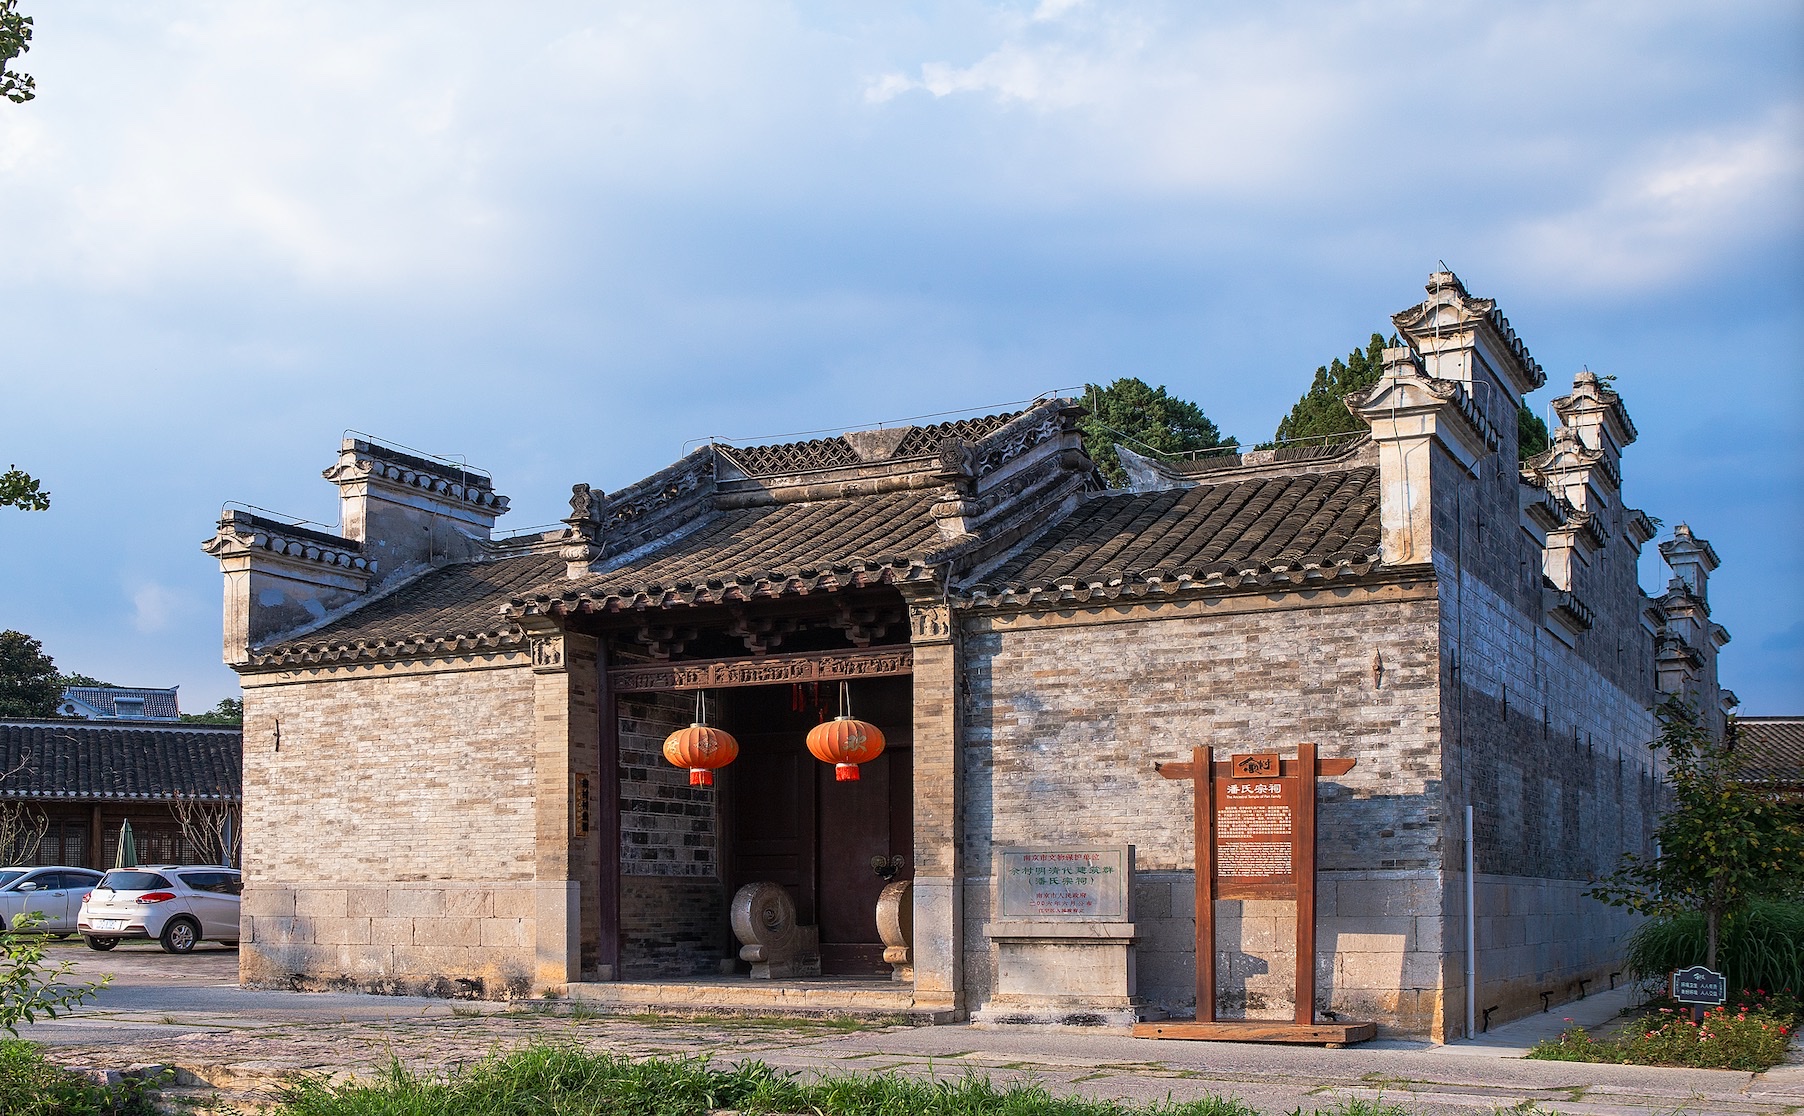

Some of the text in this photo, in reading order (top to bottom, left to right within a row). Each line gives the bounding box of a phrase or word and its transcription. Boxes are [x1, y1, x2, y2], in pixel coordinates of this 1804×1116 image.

[1226, 783, 1282, 794] 潘氏宗祠
[1023, 853, 1100, 862] 南京市文物保护单位
